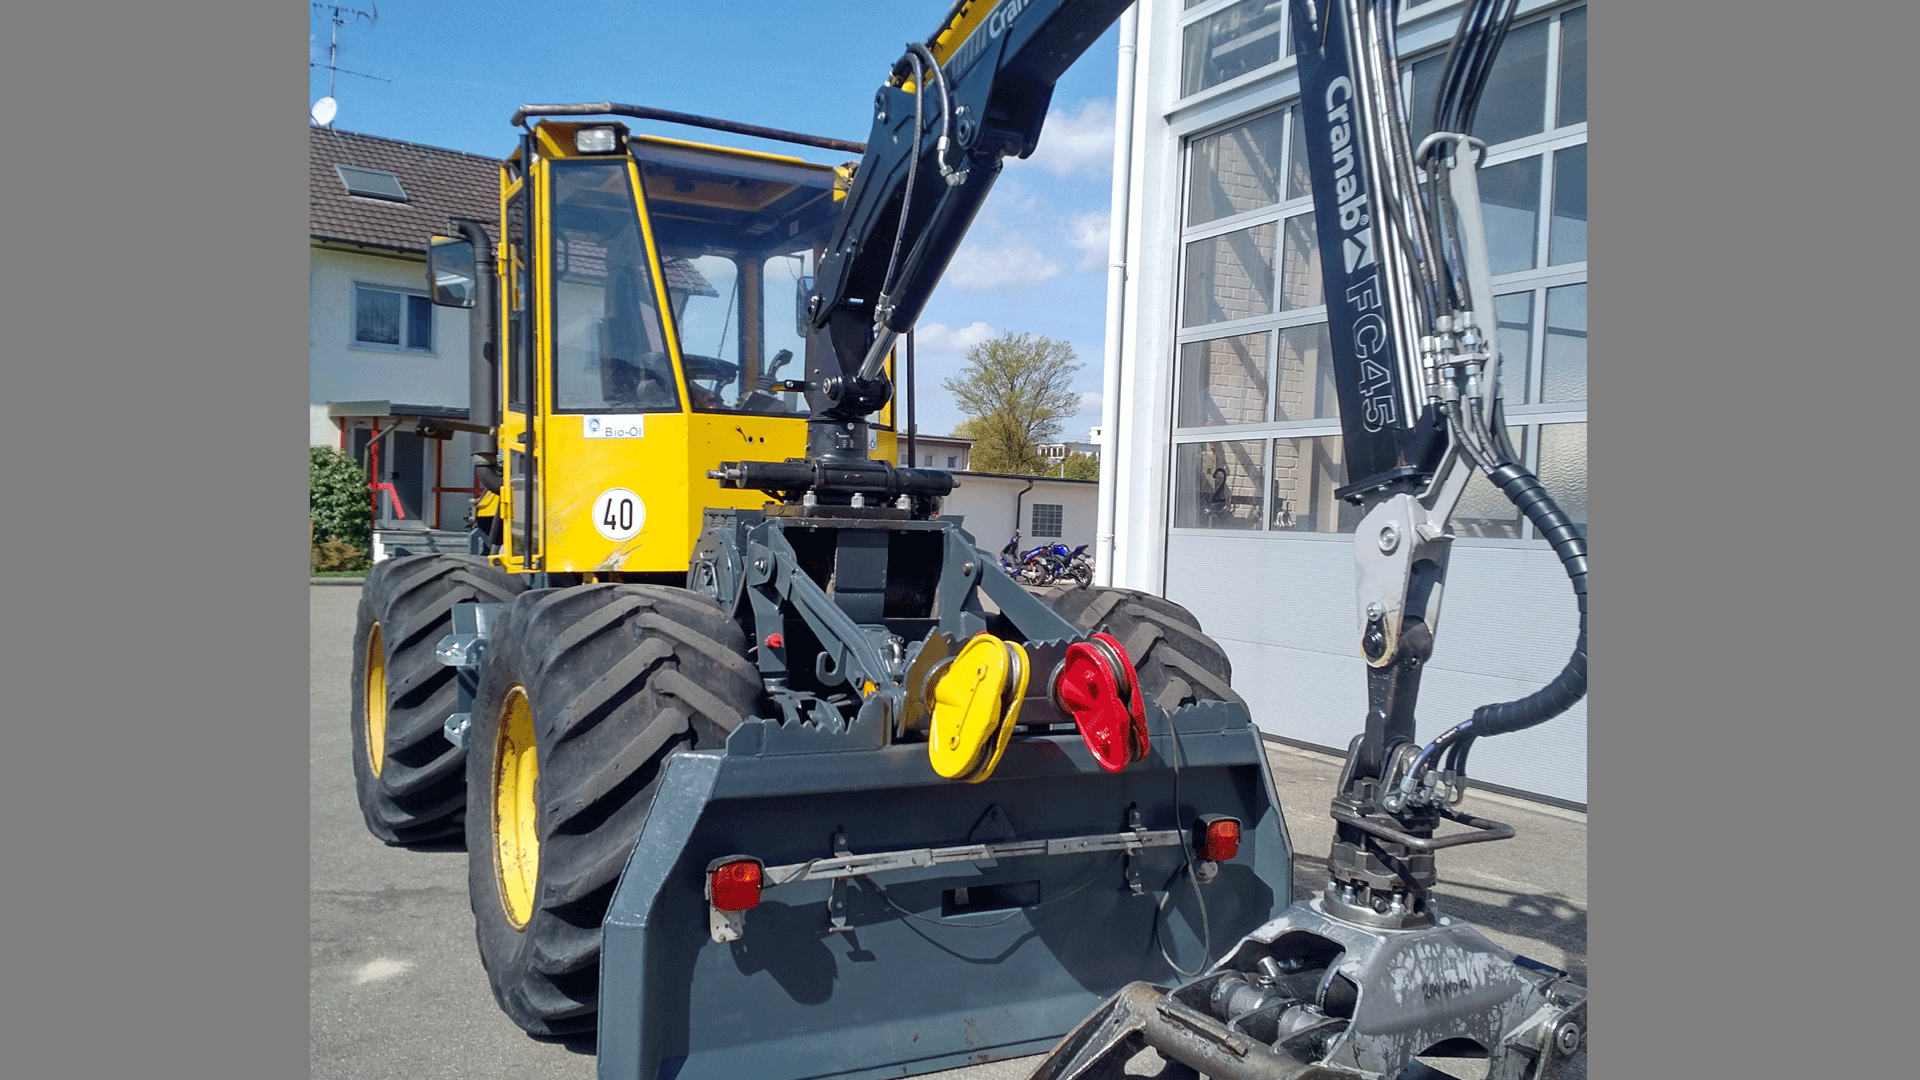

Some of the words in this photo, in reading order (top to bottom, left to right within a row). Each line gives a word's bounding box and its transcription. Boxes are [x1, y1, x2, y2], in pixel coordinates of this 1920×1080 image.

[1326, 75, 1368, 230] Cranab
[1346, 274, 1396, 433] FC45
[605, 424, 642, 437] Bio-Öl
[603, 498, 633, 531] 40
